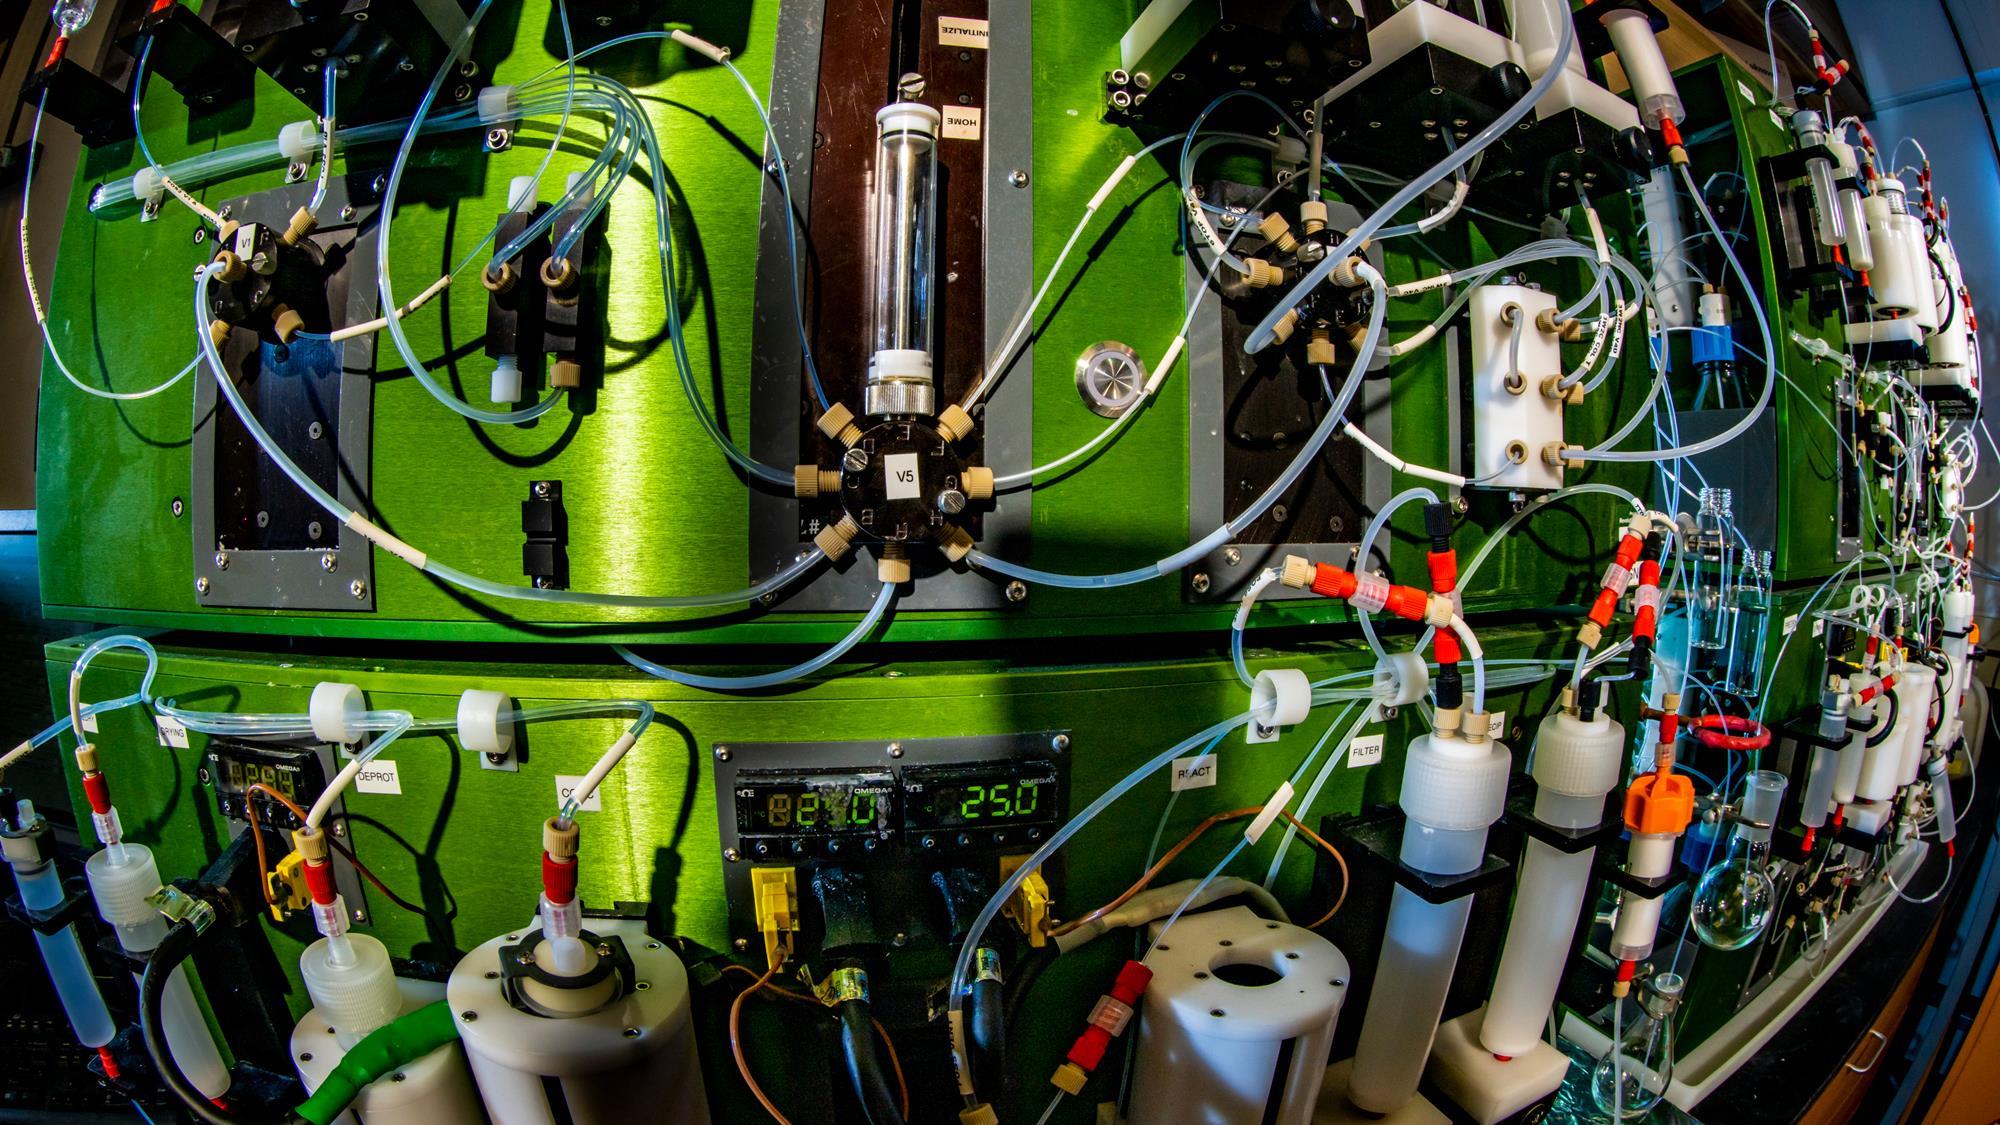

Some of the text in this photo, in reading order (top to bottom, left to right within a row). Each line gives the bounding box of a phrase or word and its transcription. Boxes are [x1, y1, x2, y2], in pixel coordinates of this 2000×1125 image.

[942, 26, 989, 37] INITIALIZE
[947, 117, 977, 127] HOME
[1198, 220, 1215, 246] STOP
[241, 238, 251, 249] V1
[896, 470, 914, 483] V5
[160, 726, 185, 738] DRYING
[1353, 745, 1380, 757] FILTER
[358, 771, 394, 783] DEPROT
[961, 783, 1038, 819] 25.0
